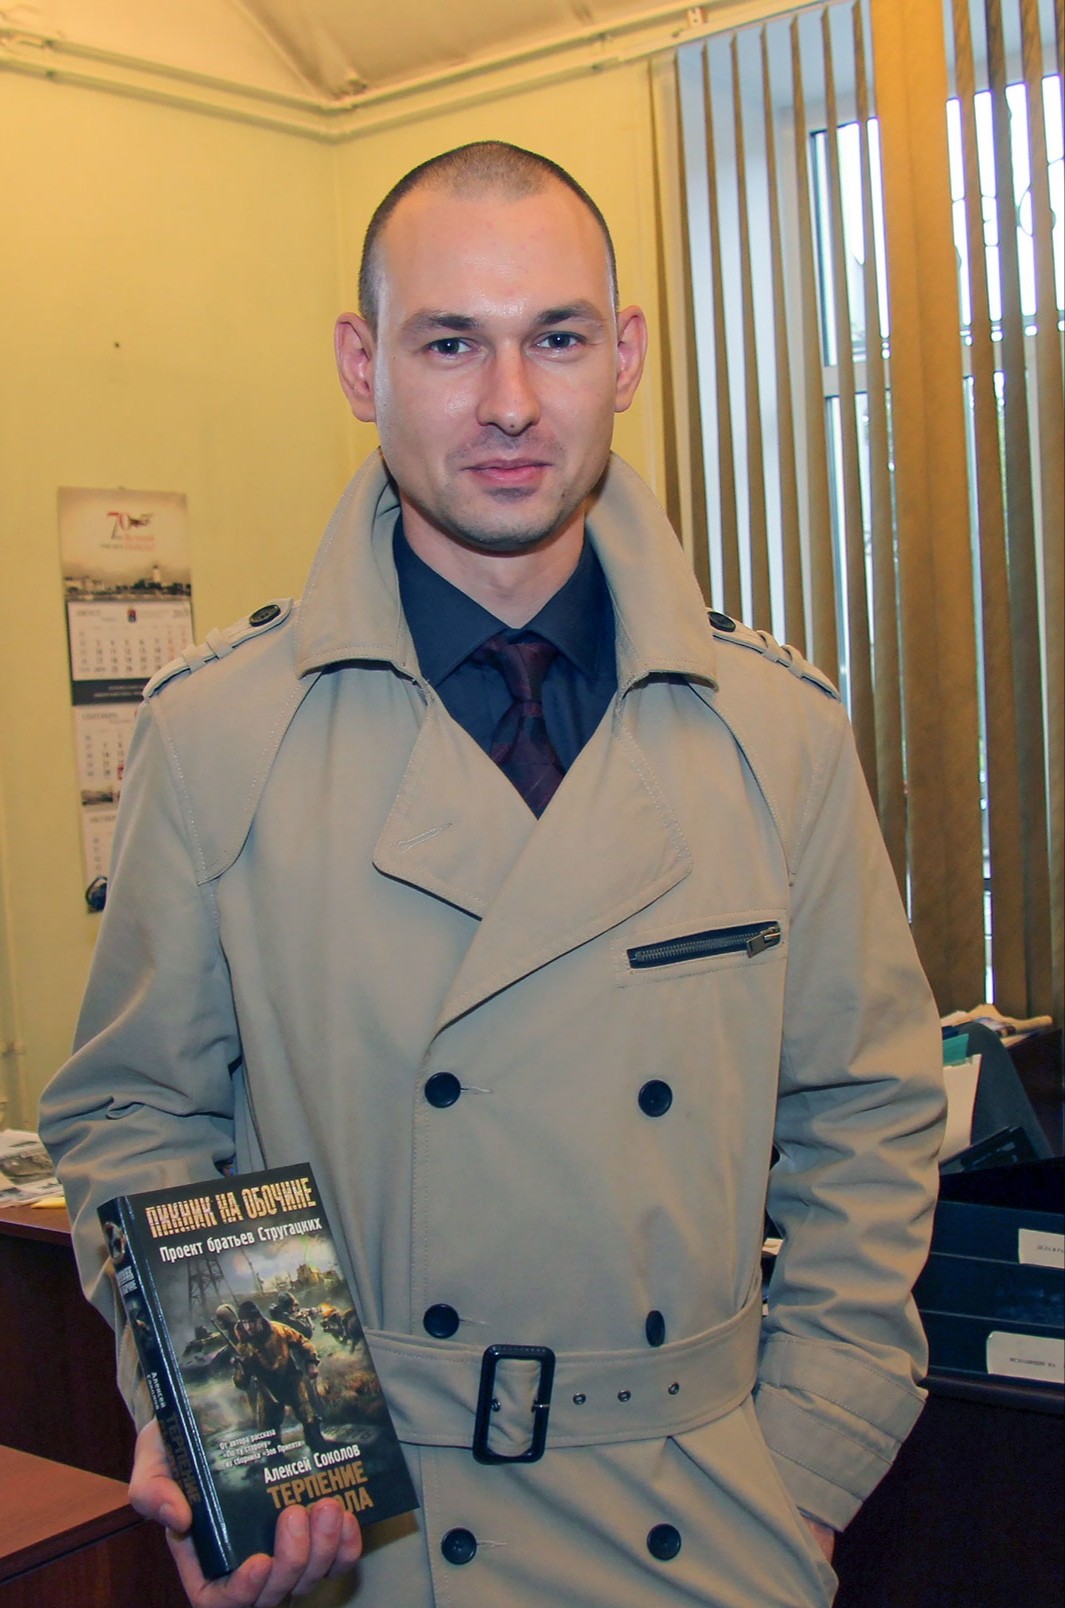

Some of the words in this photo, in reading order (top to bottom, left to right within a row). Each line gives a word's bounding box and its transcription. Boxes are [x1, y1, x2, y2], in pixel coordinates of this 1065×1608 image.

[145, 1196, 218, 1238] ПИКНИК
[215, 1191, 244, 1224] НА
[241, 1177, 317, 1219] ОБОЧИНЕ
[159, 1241, 203, 1264] Проект
[206, 1231, 256, 1256] братьев
[257, 1217, 323, 1241] Стругацких
[264, 1456, 313, 1484] Алексей
[313, 1444, 361, 1468] Соколов
[266, 1460, 369, 1510] ТЕРПЕНИЕ
